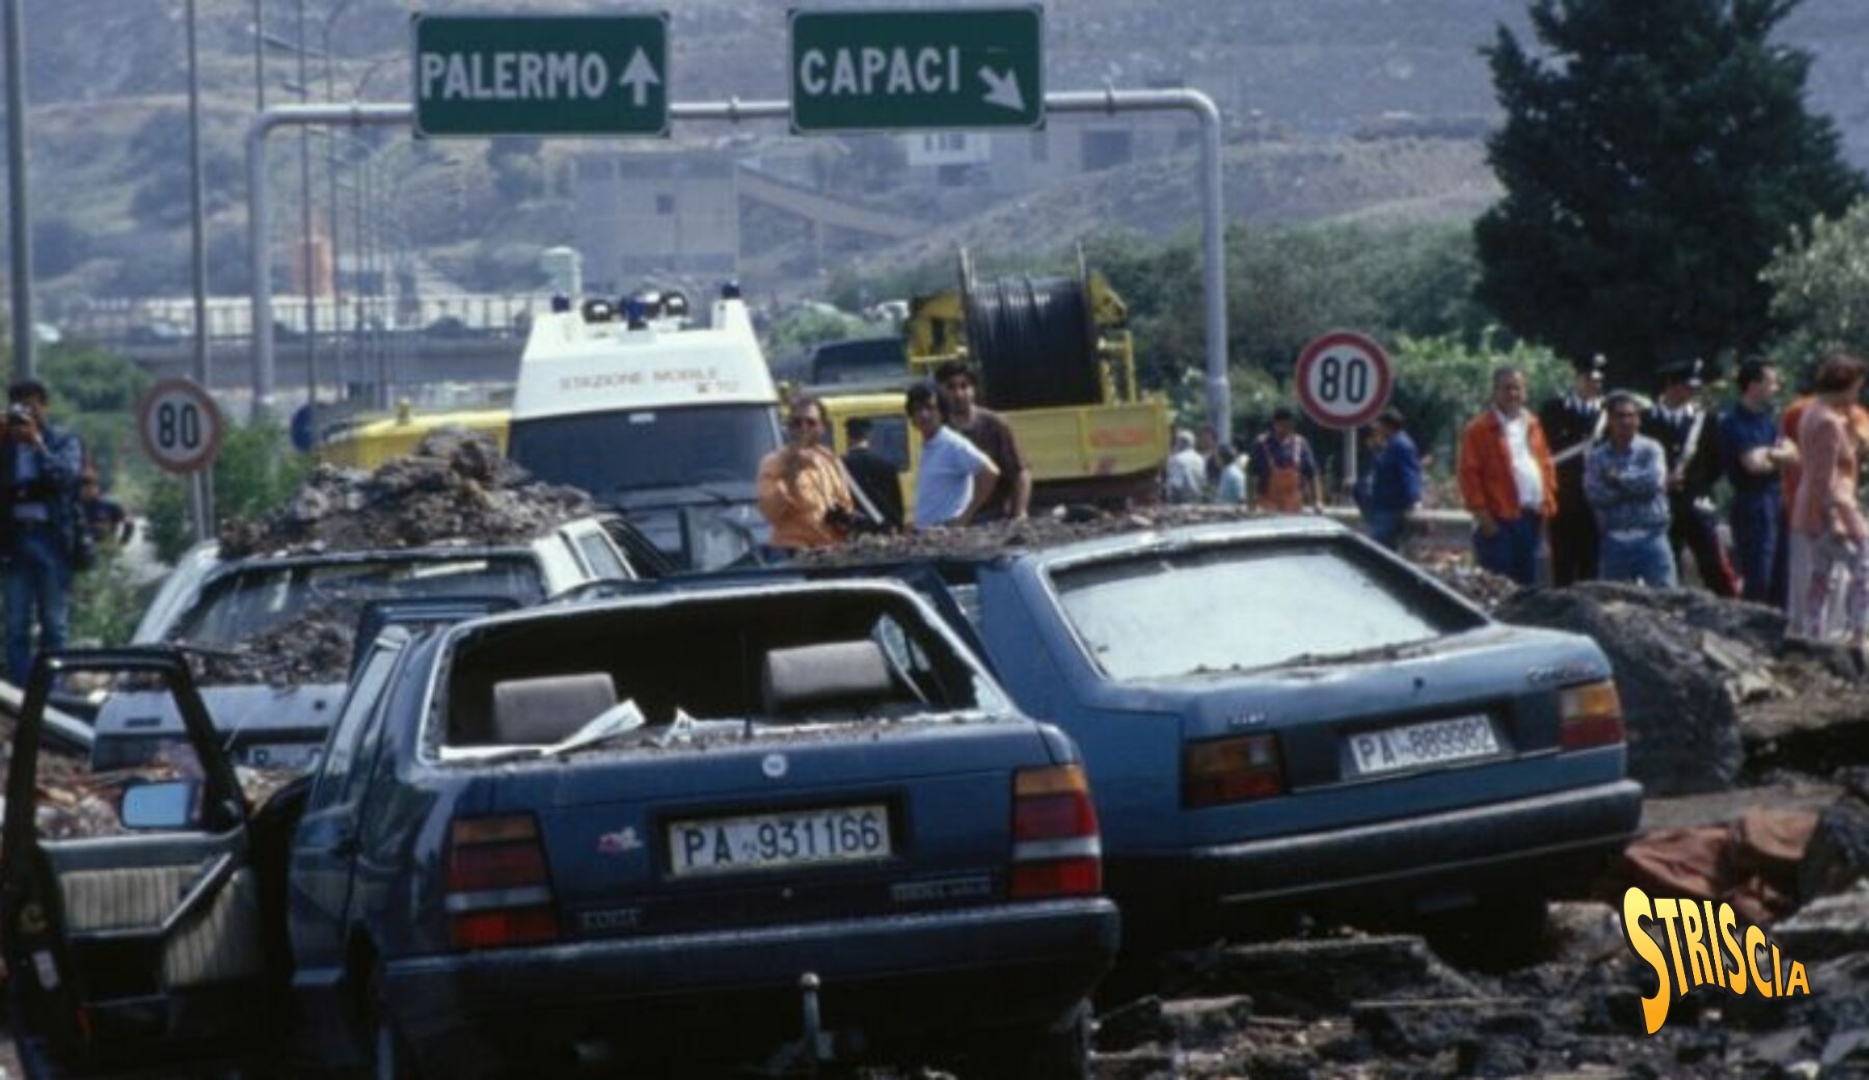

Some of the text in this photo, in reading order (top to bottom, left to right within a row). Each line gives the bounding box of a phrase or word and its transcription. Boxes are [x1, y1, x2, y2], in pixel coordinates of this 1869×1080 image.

[420, 52, 608, 99] PALERMO
[800, 46, 960, 96] CAPACI
[1320, 356, 1368, 404] 80
[158, 401, 201, 450] 80
[1357, 735, 1397, 767] PA
[683, 812, 881, 867] PA 931166
